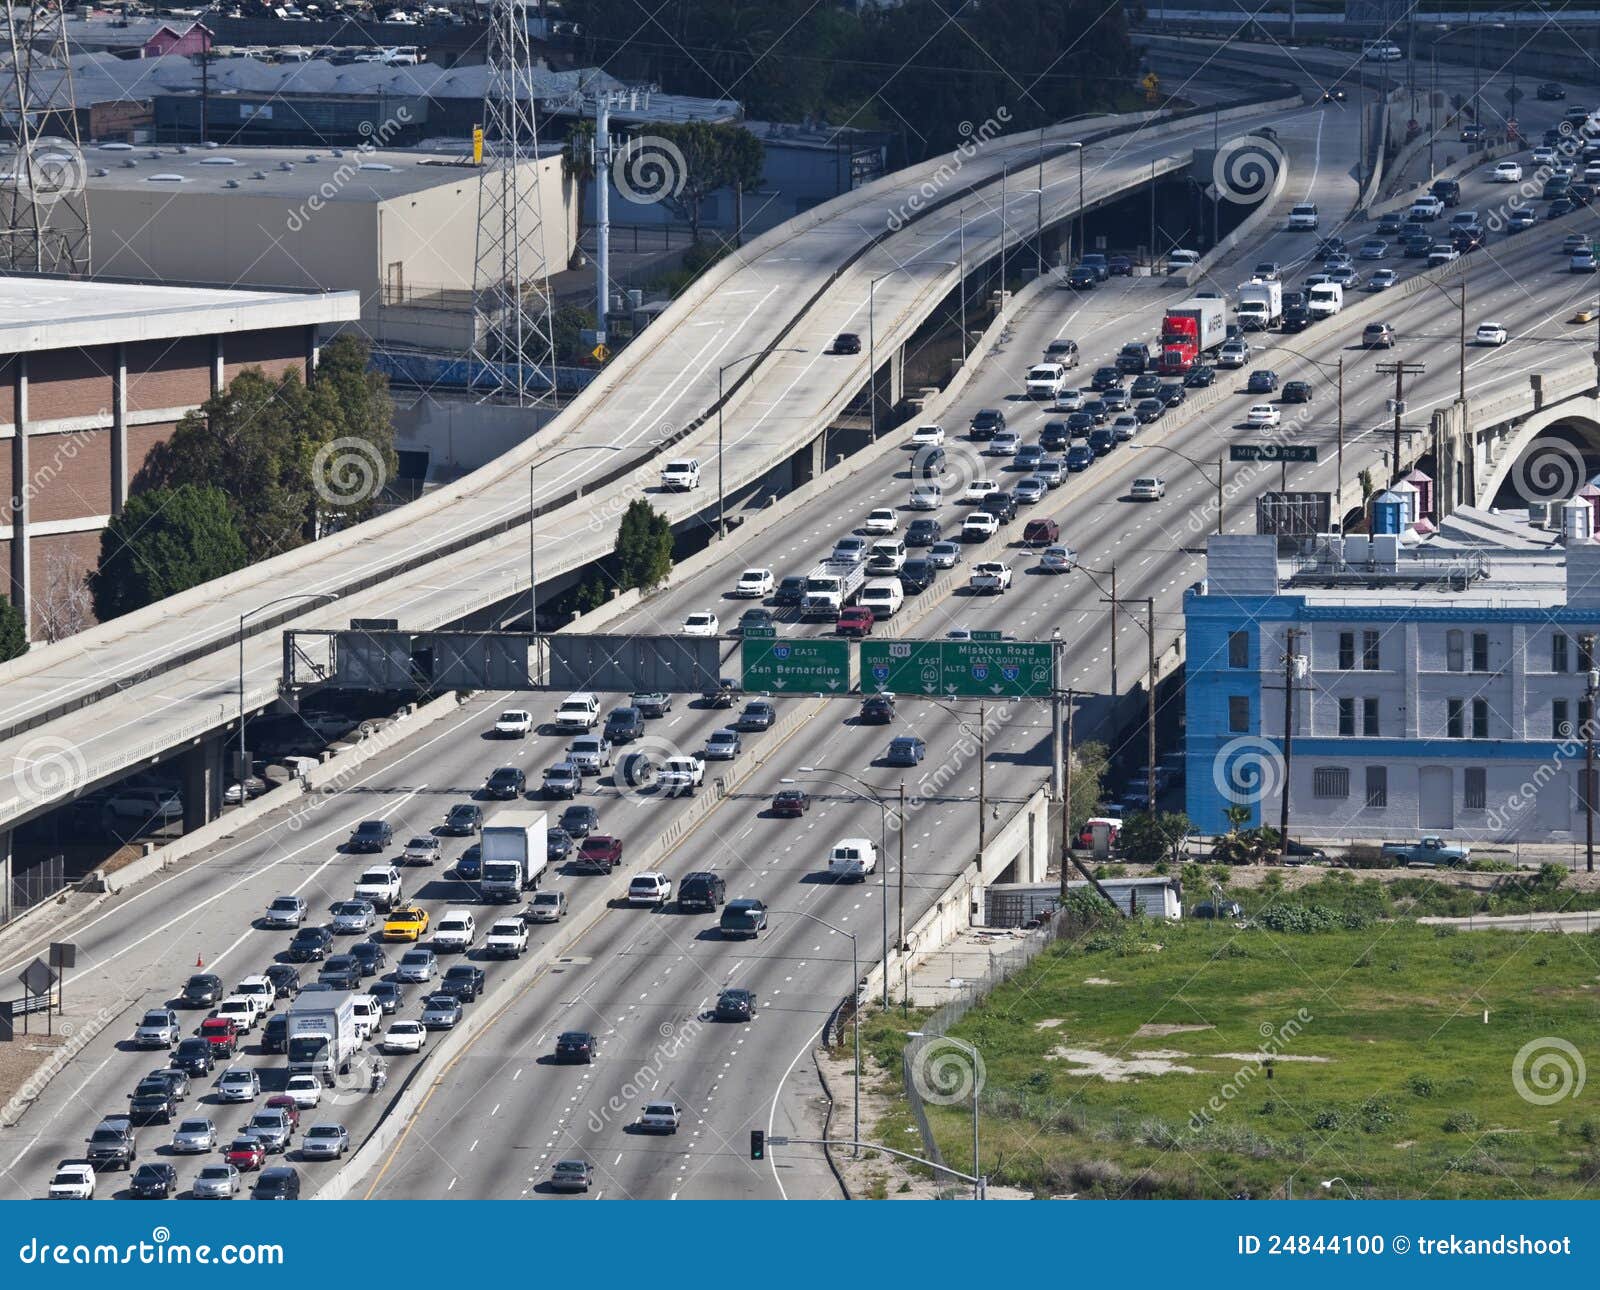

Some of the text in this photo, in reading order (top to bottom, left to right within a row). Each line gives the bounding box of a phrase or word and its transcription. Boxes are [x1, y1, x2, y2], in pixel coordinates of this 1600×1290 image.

[776, 648, 818, 657] 10 EAST
[892, 646, 908, 655] 101
[958, 645, 1035, 655] Mission Road
[867, 656, 941, 665] SOUTH EAST
[969, 656, 1051, 665] EAST SOUTH EAST
[750, 664, 841, 675] San Bernardino
[923, 670, 935, 679] 60
[975, 669, 986, 678] 10
[1034, 671, 1046, 680] 60
